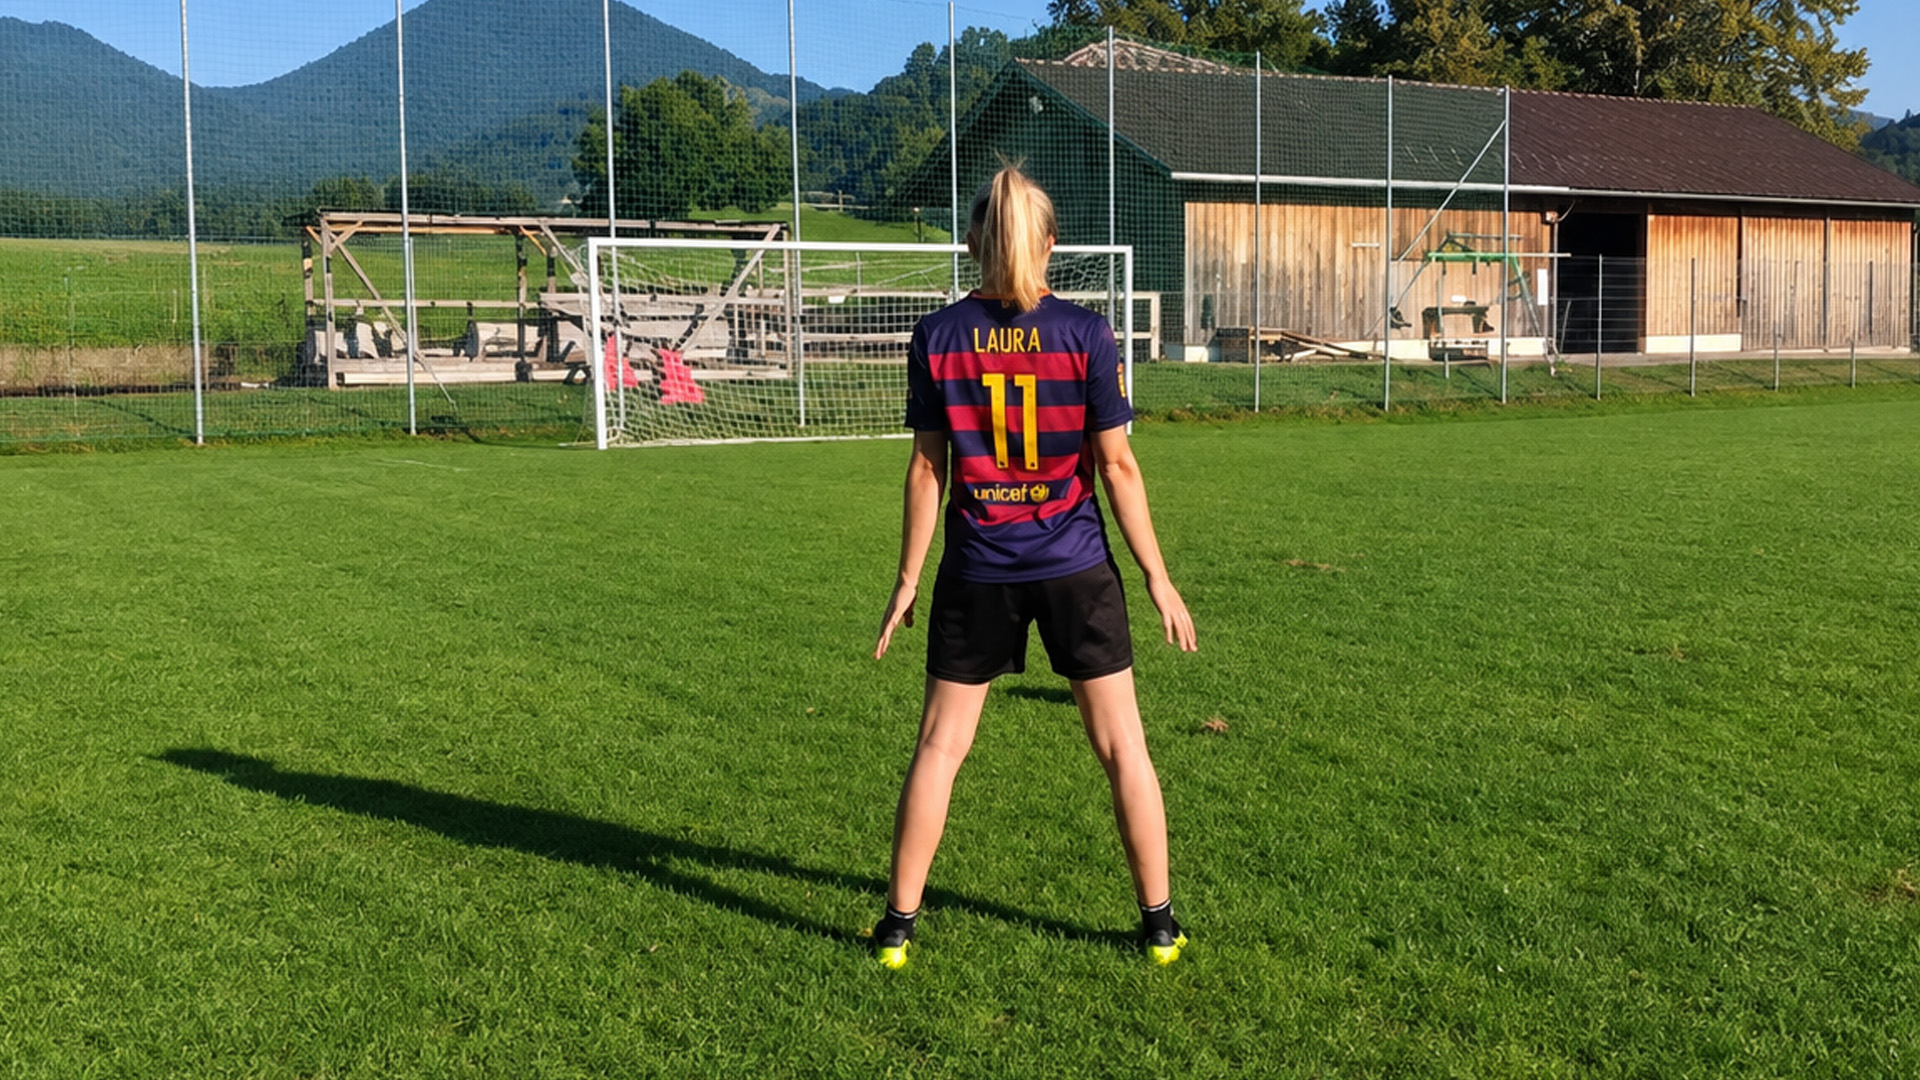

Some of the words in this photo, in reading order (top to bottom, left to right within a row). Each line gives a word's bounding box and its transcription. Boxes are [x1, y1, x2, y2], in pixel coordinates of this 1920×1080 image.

[973, 327, 1041, 353] LAURA
[982, 373, 1038, 470] 11
[973, 483, 1027, 502] unicef
